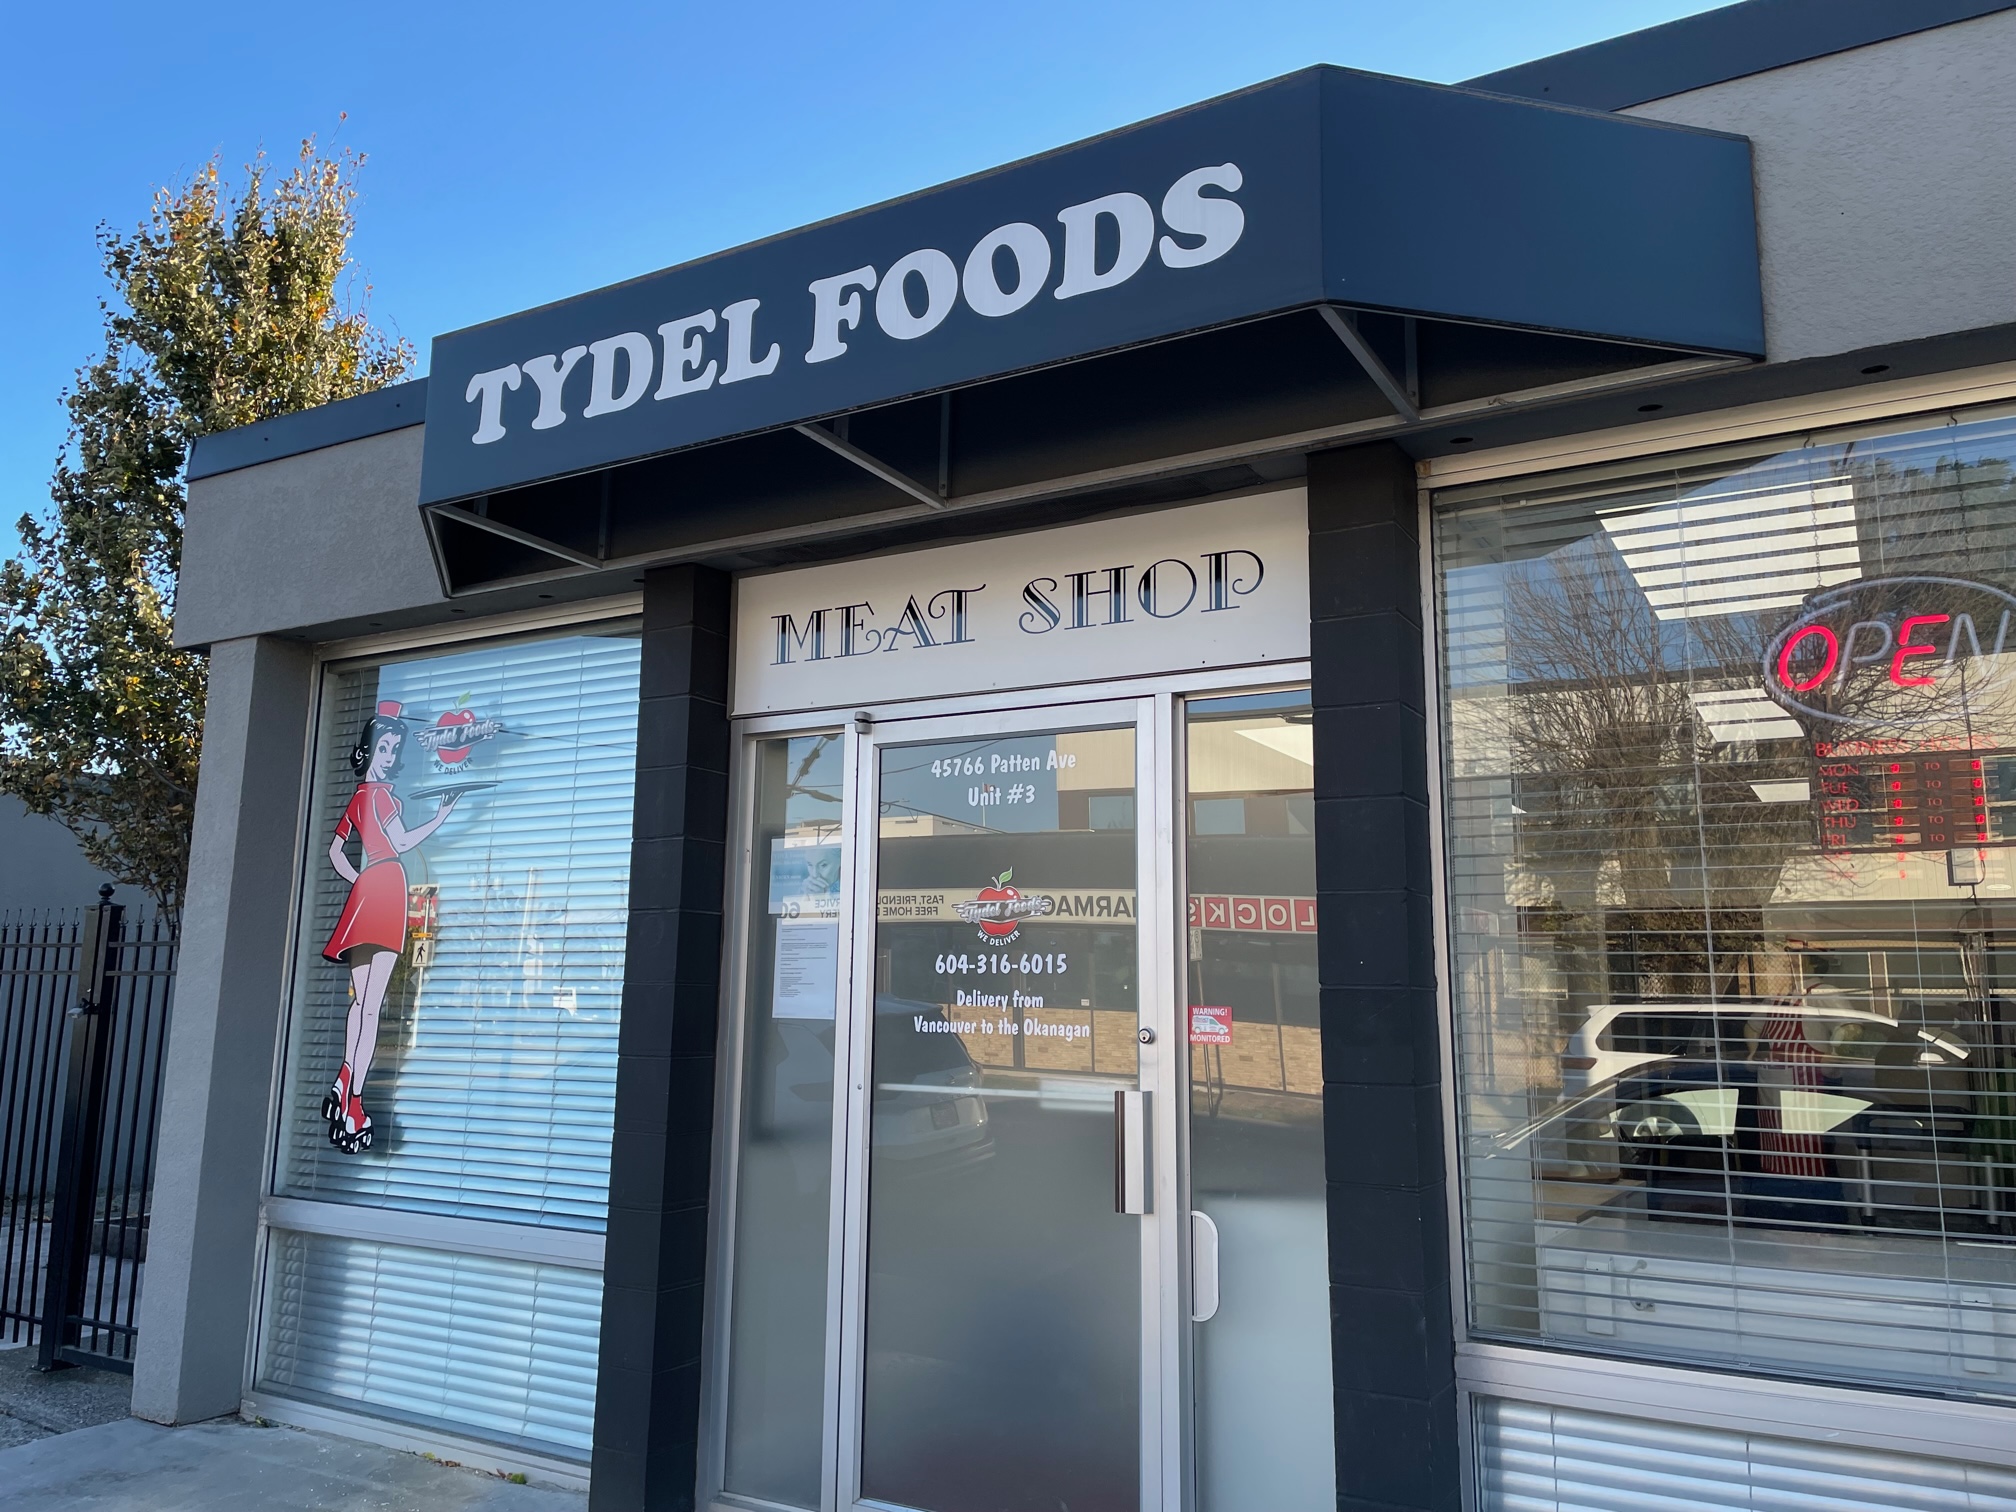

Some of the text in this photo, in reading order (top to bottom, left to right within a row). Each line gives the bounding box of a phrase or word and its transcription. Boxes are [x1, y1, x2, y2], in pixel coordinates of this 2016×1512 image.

[465, 162, 1245, 445] TYDEL FOODS
[770, 549, 1264, 665] MEAT SHOP
[1778, 610, 2011, 691] OPEN
[424, 719, 494, 753] Tydel Foods
[433, 757, 474, 776] WE DELIVER
[931, 750, 1077, 778] 45766 Patten Ave
[1818, 762, 1940, 777] MON TO
[967, 783, 1036, 807] Unit #3
[1820, 780, 1941, 795] TUE TO
[1927, 798, 1943, 807] TO
[1823, 815, 1944, 829] THU TO
[1823, 833, 1945, 846] FRI TO
[964, 896, 1042, 924] Tydel Foods
[976, 929, 1021, 947] WE DELIVER
[935, 953, 1068, 975] 604-316-6015
[956, 989, 1044, 1012] Delivery from
[1192, 1007, 1228, 1017] WARNING!
[914, 1015, 1090, 1042] Vancouver to the Okanagan
[1189, 1034, 1231, 1043] MONITORED
